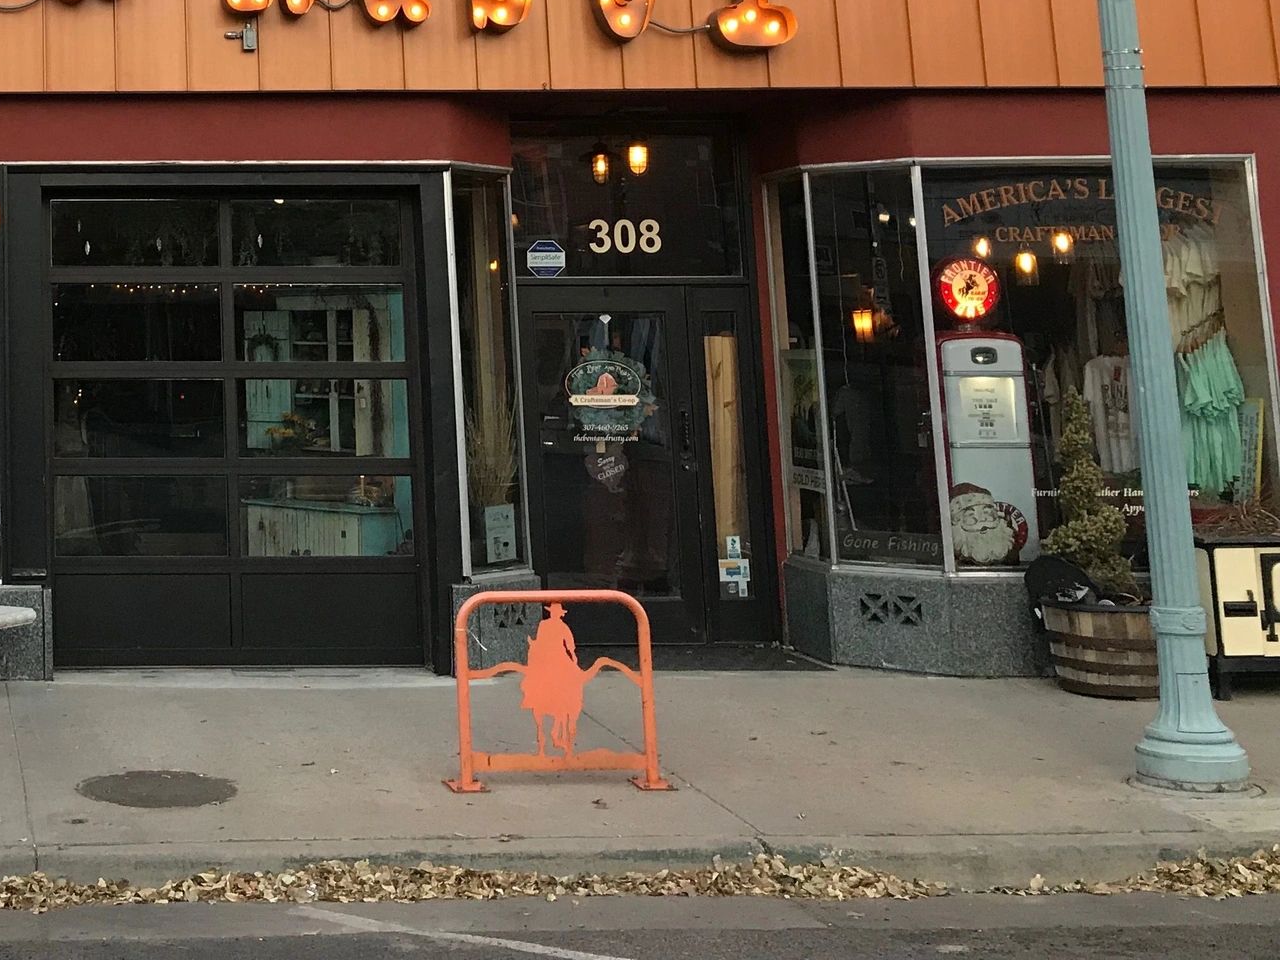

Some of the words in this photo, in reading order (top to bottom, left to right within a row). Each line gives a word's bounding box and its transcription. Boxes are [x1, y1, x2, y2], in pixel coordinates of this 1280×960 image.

[941, 178, 1090, 228] AMERICA'S
[1098, 179, 1219, 225] LGES
[588, 219, 662, 254] 308
[940, 259, 995, 284] FRONTIER
[597, 464, 625, 481] CLOSED
[792, 472, 810, 485] SOLD
[843, 534, 879, 549] Gone
[888, 536, 940, 558] Fishing
